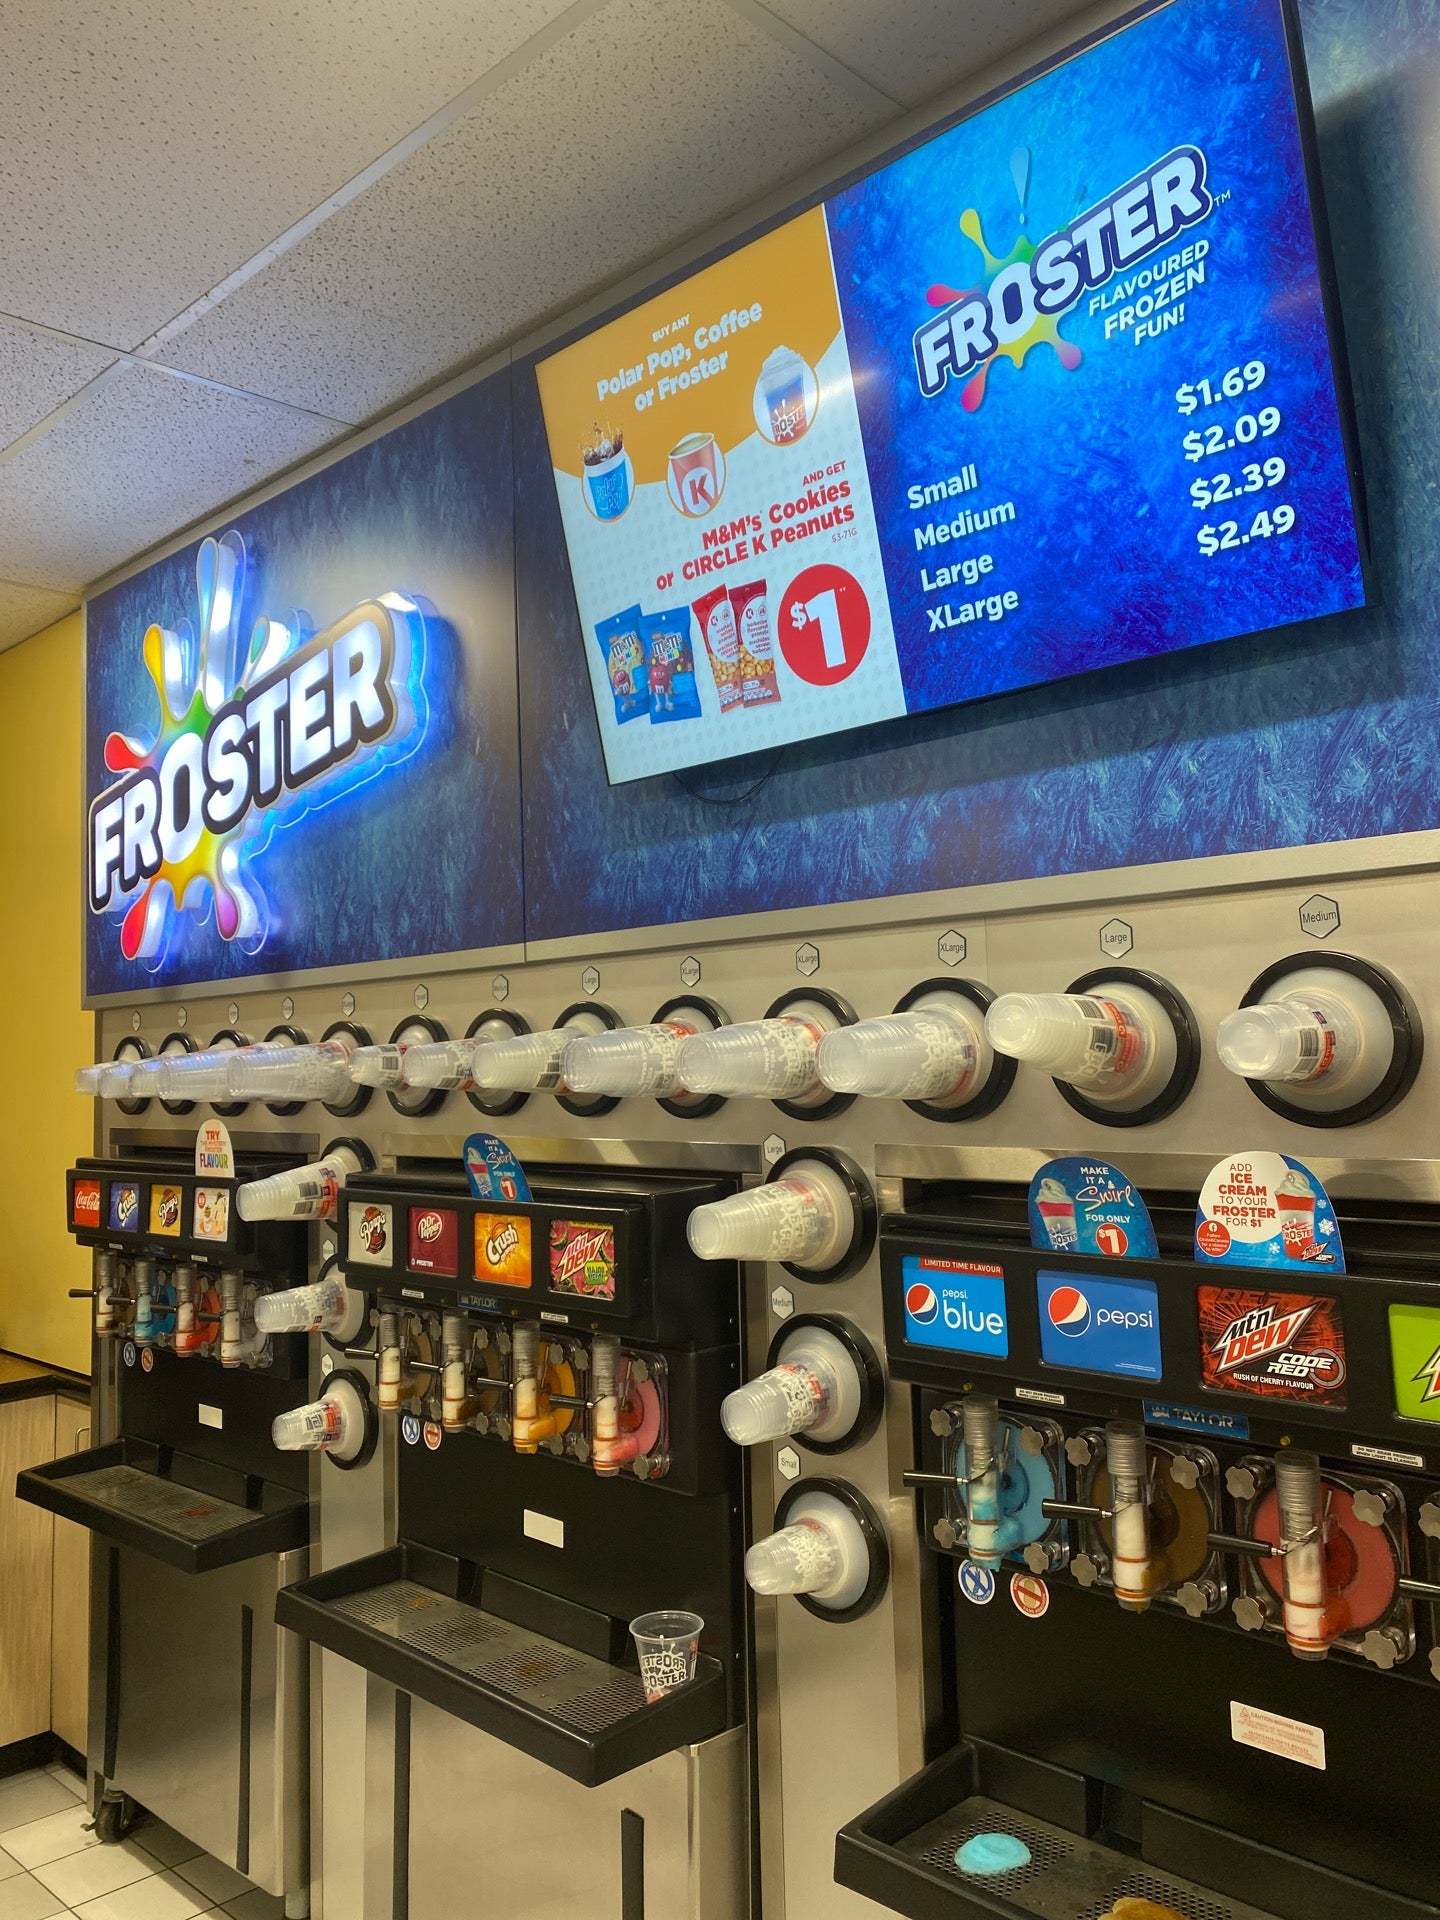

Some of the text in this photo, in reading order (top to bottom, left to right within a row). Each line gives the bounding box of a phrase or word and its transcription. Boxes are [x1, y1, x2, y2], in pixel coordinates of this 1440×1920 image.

[916, 150, 1207, 390] FROSTER
[1088, 239, 1210, 316] FLAVOURED
[1104, 262, 1206, 339] FROZEN
[652, 314, 690, 342] BUY ANY
[1134, 303, 1186, 345] FUN!
[597, 303, 763, 400] Polar Pop, Coffee
[634, 351, 729, 412] or Froster
[1175, 359, 1266, 415] $1.69
[1182, 406, 1281, 464] $2.09
[802, 460, 846, 486] AND GET
[1189, 456, 1287, 510] $2.39
[689, 473, 714, 505] K
[906, 463, 978, 509] Small
[702, 480, 850, 550] M&M's Cookies
[913, 500, 1016, 550] Medium
[831, 527, 857, 544] 53-71G
[1196, 503, 1297, 558] $2.49
[656, 504, 855, 591] or CIRCLE K Peanuts
[920, 554, 993, 592] Large
[926, 587, 1019, 632] XLarge
[93, 614, 388, 902] FROSTER
[1302, 911, 1337, 924] Medium
[940, 943, 965, 954] XLarge
[1105, 932, 1128, 944] Large
[797, 954, 817, 963] XLarge
[205, 1130, 221, 1141] TRY
[200, 1153, 229, 1169] FLAVOUR
[1080, 1167, 1109, 1175] MAKE
[1229, 1163, 1252, 1172] ADD
[1218, 1184, 1267, 1196] CREAM
[1230, 1173, 1253, 1184] ICE
[1076, 1185, 1135, 1211] Swirl
[1220, 1195, 1267, 1206] TO YOUR
[425, 1215, 436, 1228] Dr
[1085, 1214, 1130, 1223] FOR ONLY
[1213, 1205, 1276, 1219] FROSTER
[1226, 1217, 1248, 1226] FOR
[418, 1218, 441, 1239] Pepper
[487, 1224, 519, 1264] Crush
[1098, 1228, 1120, 1254] $1
[924, 1259, 1001, 1274] LIMITED TIME FLAVOUR
[469, 1295, 496, 1308] TAYLOR
[943, 1299, 1004, 1334] blue
[1097, 1308, 1153, 1329] pepsi
[1224, 1311, 1271, 1343] Mtn
[1267, 1362, 1310, 1377] RED
[1277, 1353, 1335, 1370] CODE
[1233, 1373, 1314, 1390] RUSH OF CHERRY FLAVOUR
[1173, 1407, 1234, 1428] TAYLOR
[780, 1457, 797, 1469] Small
